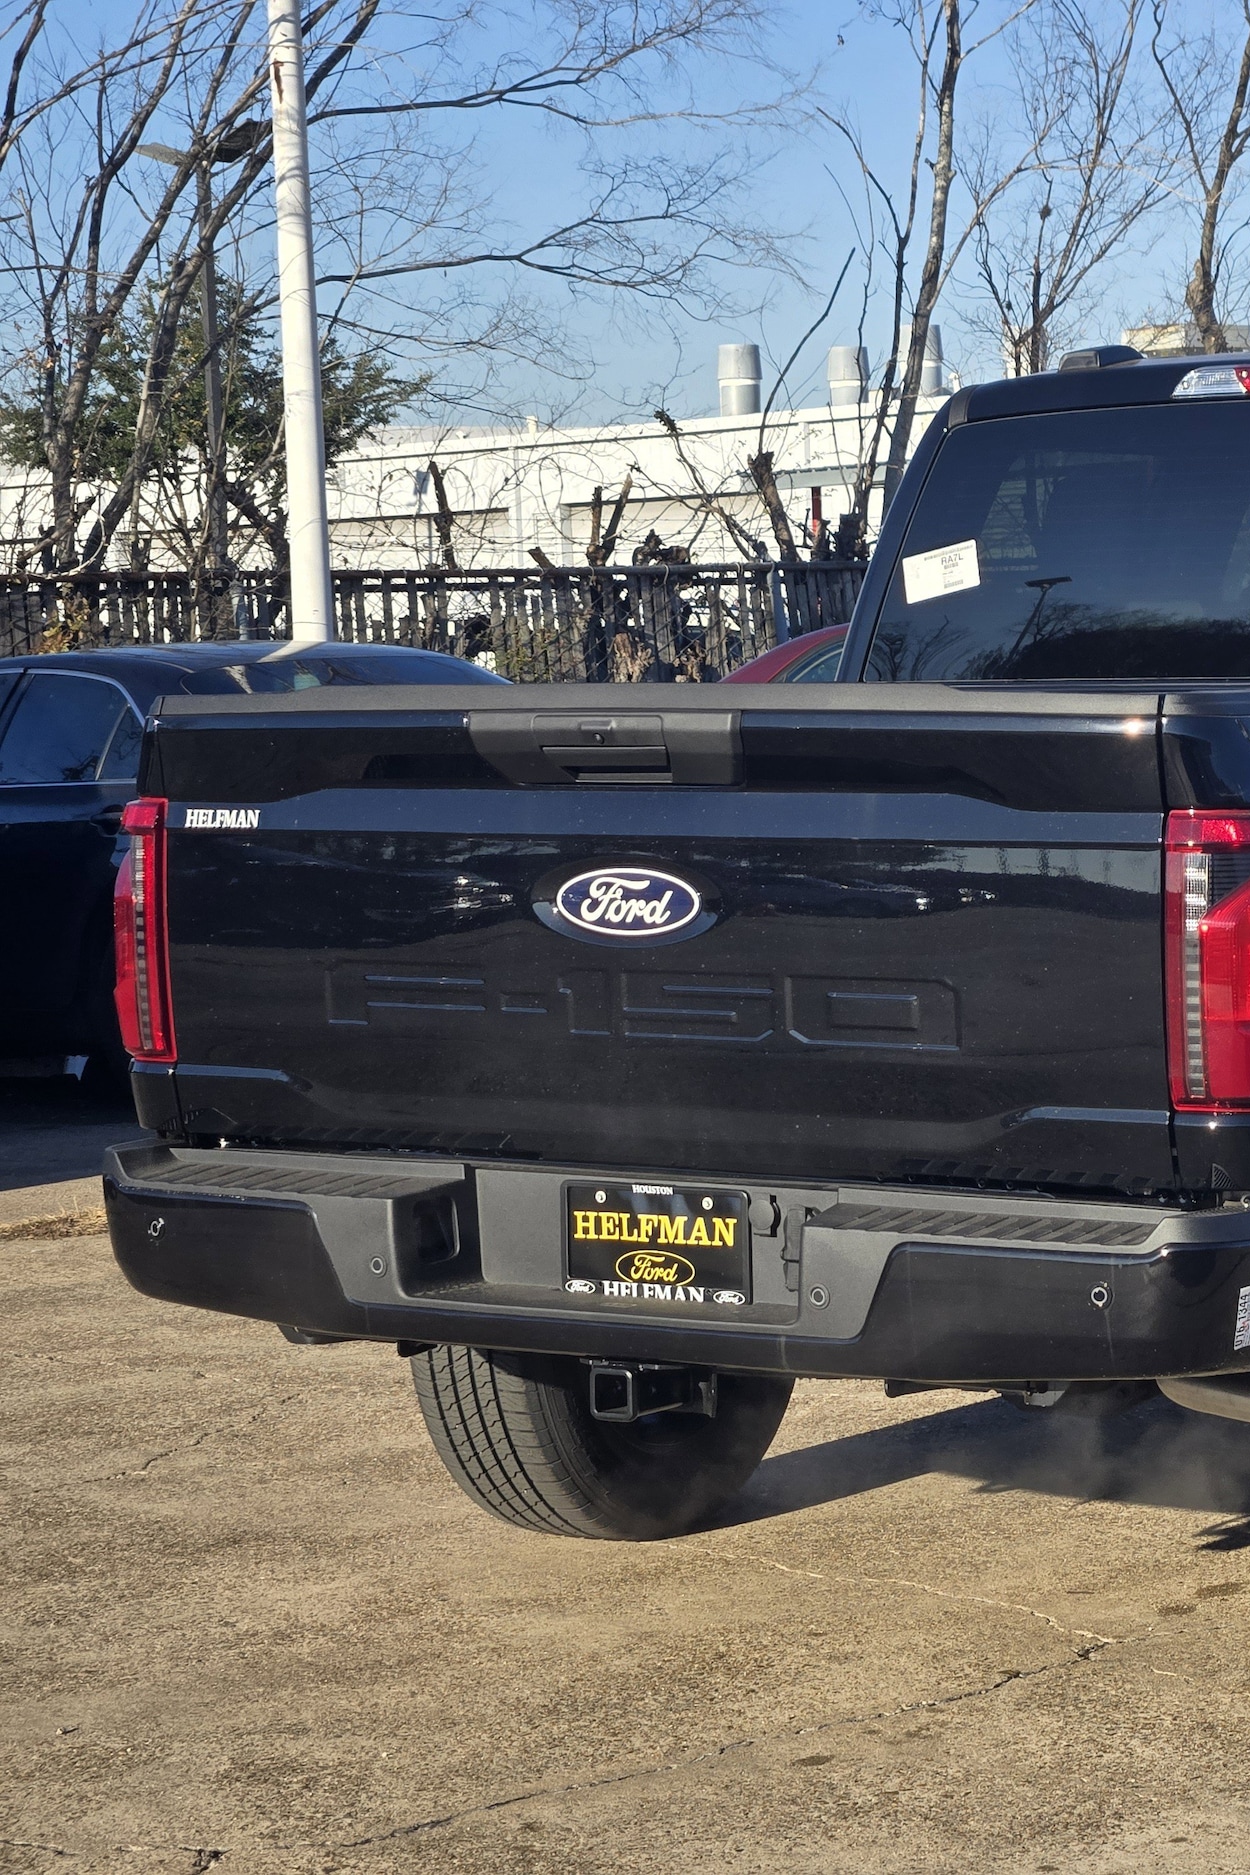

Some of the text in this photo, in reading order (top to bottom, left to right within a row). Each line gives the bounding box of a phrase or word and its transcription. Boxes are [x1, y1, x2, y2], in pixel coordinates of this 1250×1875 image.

[184, 808, 261, 829] HELFMAN
[581, 877, 673, 924] Ford
[326, 960, 963, 1051] F-150
[631, 1184, 674, 1196] HOUSTON
[573, 1211, 738, 1247] HELFMAN
[630, 1253, 679, 1283] Ford
